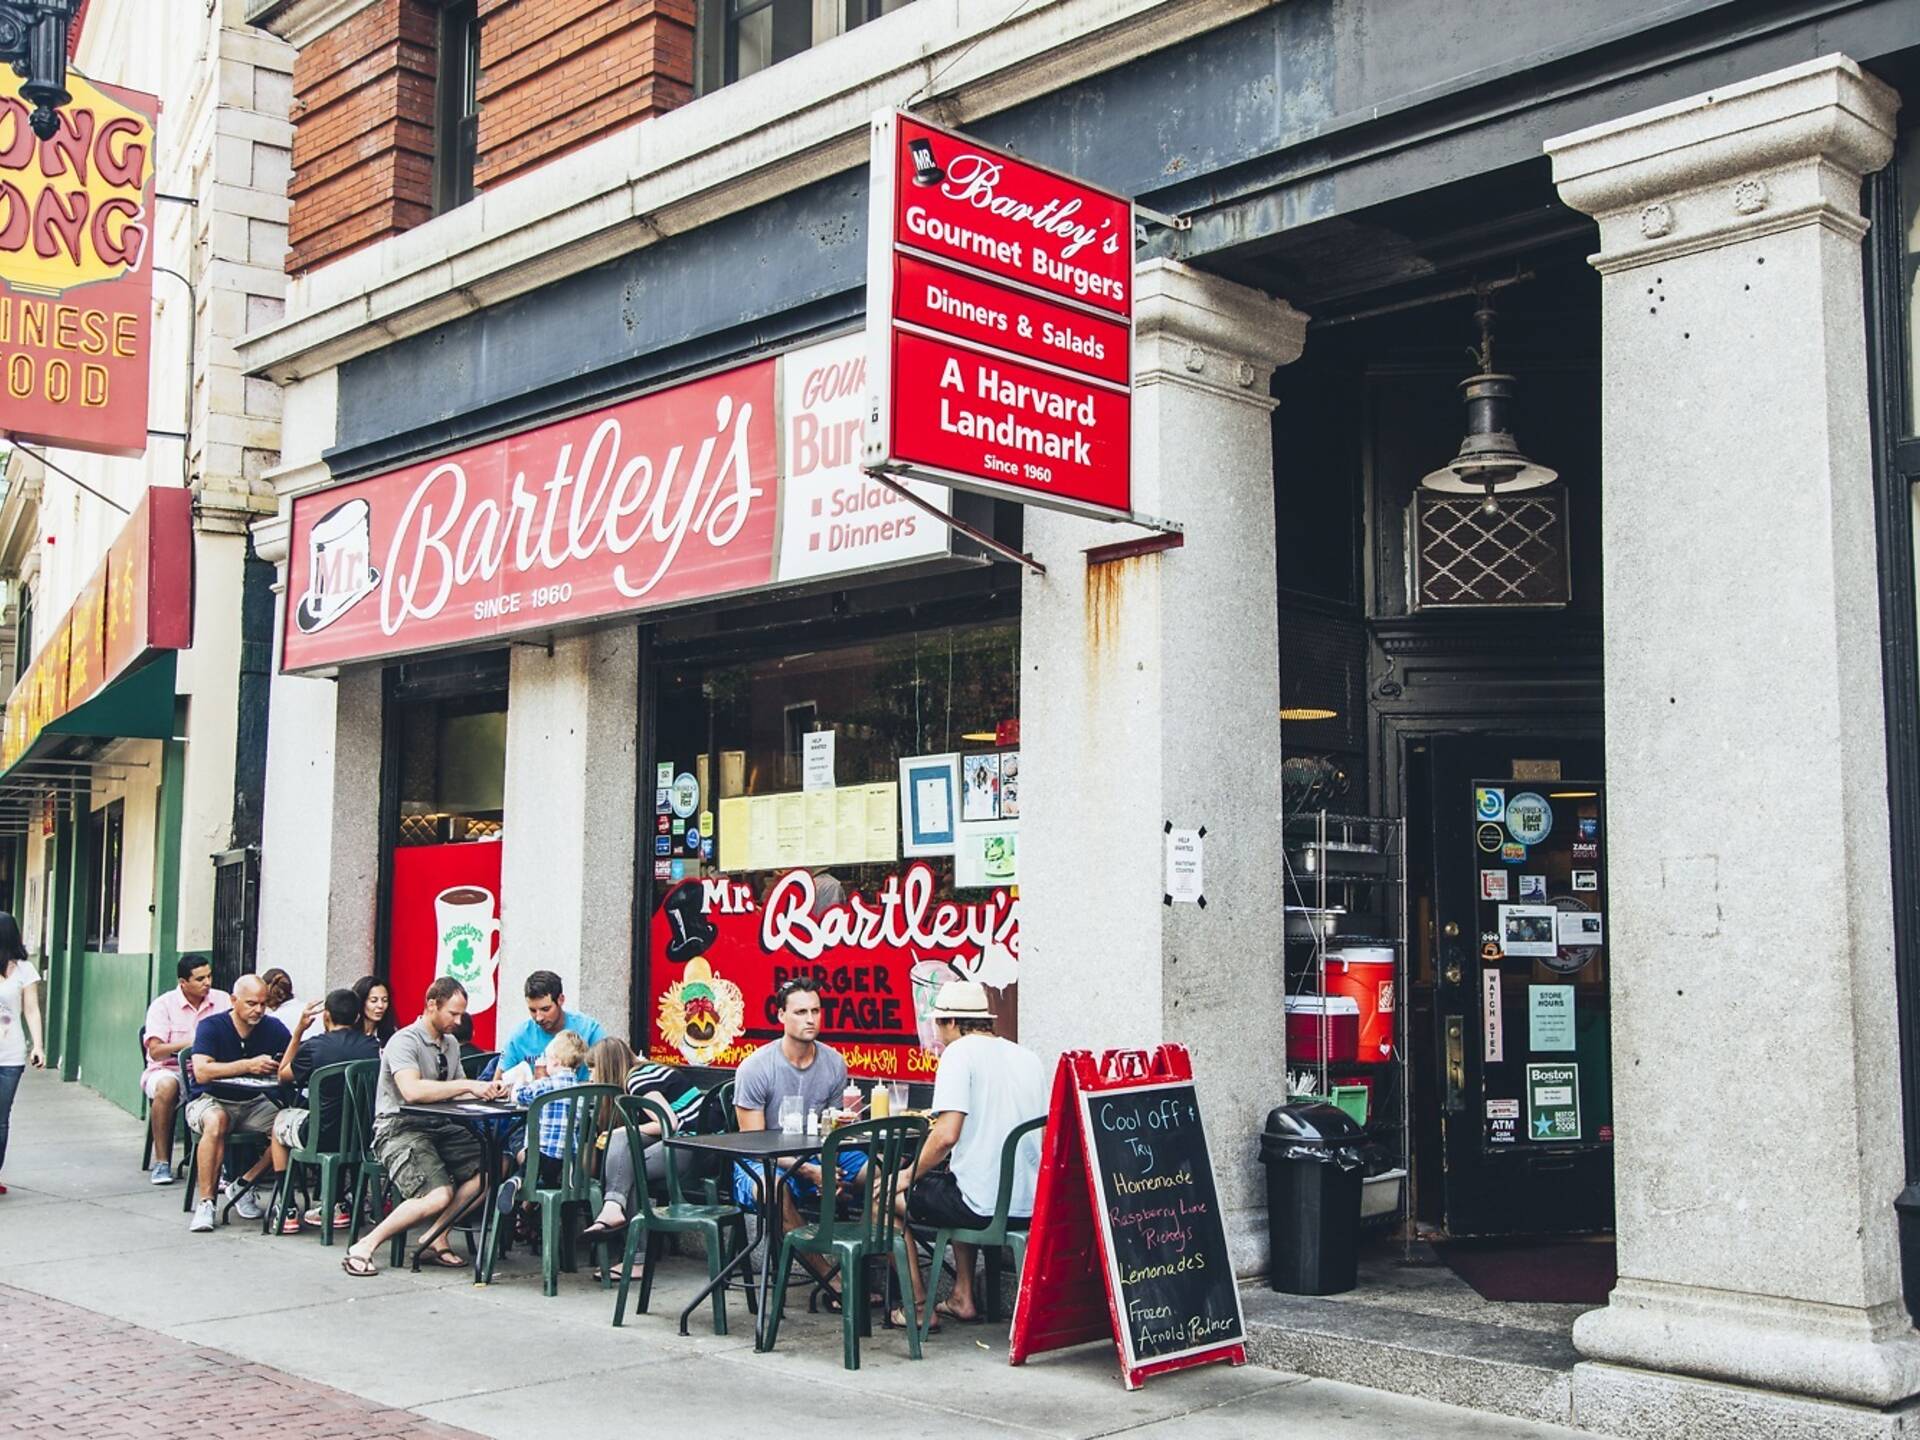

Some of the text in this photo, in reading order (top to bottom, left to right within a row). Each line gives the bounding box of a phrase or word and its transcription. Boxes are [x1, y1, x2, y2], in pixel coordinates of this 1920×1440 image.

[913, 149, 936, 171] MR.
[941, 155, 1119, 259] Bartley's
[906, 206, 1124, 301] Gourmet Burgers
[926, 285, 1105, 360] Dinners & Salads
[0, 352, 109, 408] OOD
[940, 357, 1097, 427] A Harvard
[792, 412, 865, 477] Bur
[940, 398, 1092, 466] Landmark
[984, 454, 1052, 483] Since 1960
[316, 395, 763, 636] Mr. Bartley's
[828, 516, 916, 552] Dinners
[474, 582, 573, 620] SINCE 1960
[1522, 814, 1542, 822] Local
[1522, 822, 1541, 832] First
[700, 867, 1019, 982] Mr. Bartley's
[765, 994, 903, 1030] CTAGE
[840, 1045, 897, 1074] ANDMARK
[907, 1047, 940, 1072] SINC
[1532, 1070, 1573, 1080] Boston
[1100, 1102, 1141, 1131] Cool
[1492, 1120, 1514, 1130] ATM
[1112, 1170, 1193, 1196] Homemade
[1180, 1199, 1208, 1216] Lime
[1120, 1252, 1205, 1286] Lemonades
[1129, 1299, 1172, 1323] Frozen
[1138, 1322, 1185, 1352] Arnold
